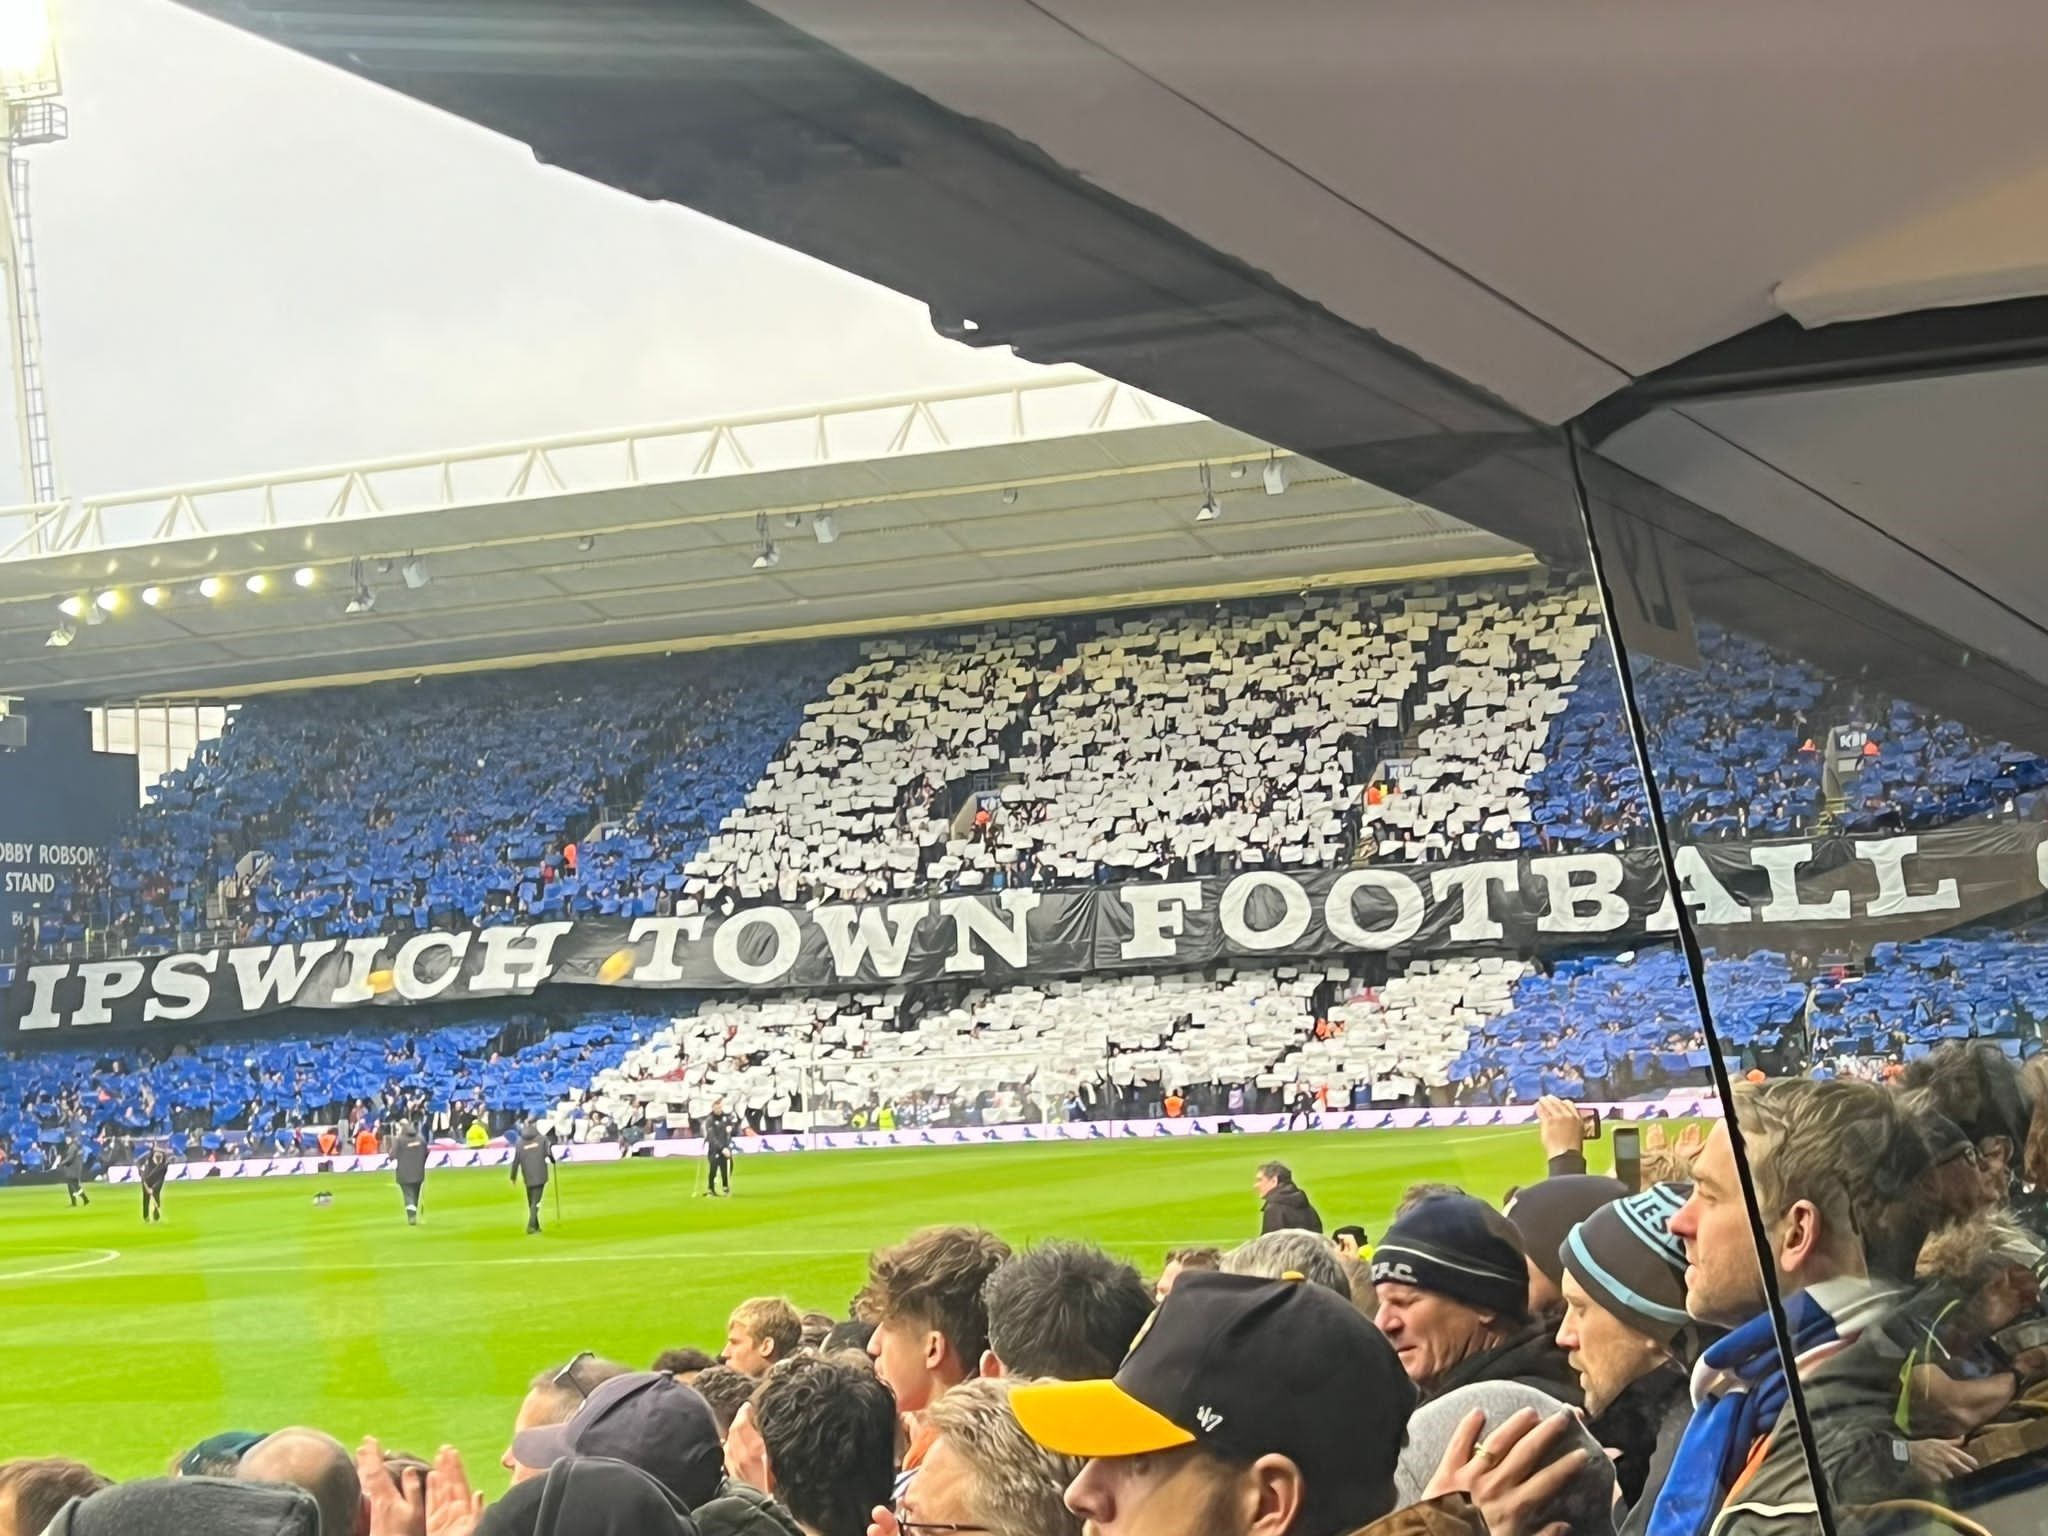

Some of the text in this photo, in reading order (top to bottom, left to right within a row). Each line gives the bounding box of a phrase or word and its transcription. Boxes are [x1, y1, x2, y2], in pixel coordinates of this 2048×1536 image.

[39, 844, 98, 866] ROBSON
[5, 871, 55, 893] STAND
[18, 921, 574, 1031] IPSWICH
[628, 887, 1041, 984] TOWN
[1120, 835, 1960, 960] FOOTBALL
